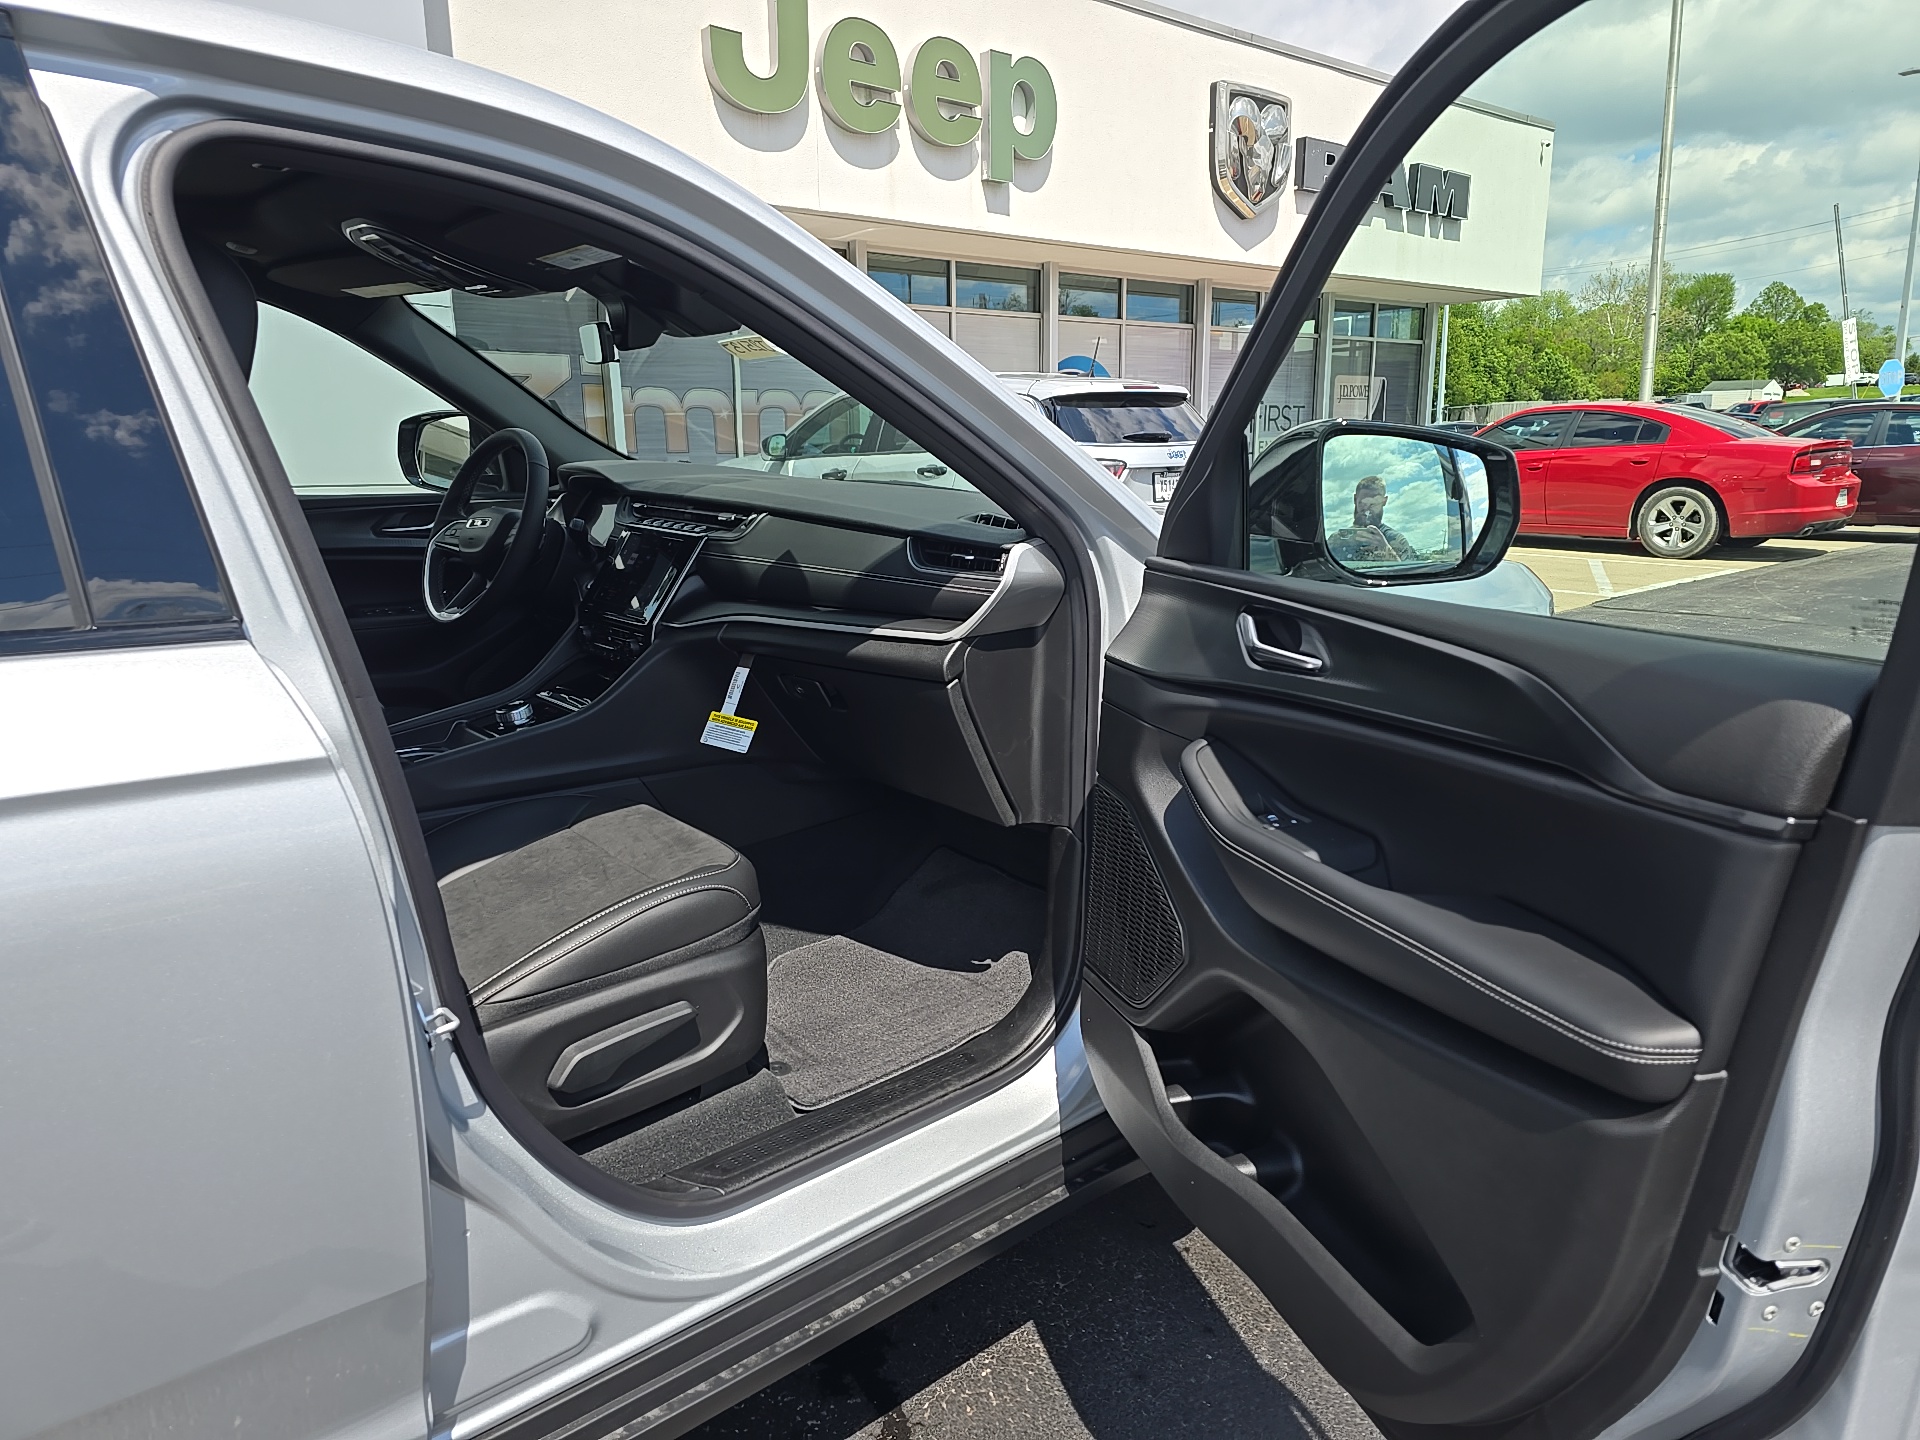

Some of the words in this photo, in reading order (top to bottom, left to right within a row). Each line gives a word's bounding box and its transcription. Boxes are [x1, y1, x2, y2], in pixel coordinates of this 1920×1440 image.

[702, 0, 1057, 184] Jeep
[1848, 322, 1860, 375] STOP
[1349, 384, 1370, 398] POWE
[1881, 369, 1904, 387] STOP
[1259, 404, 1305, 441] IRST
